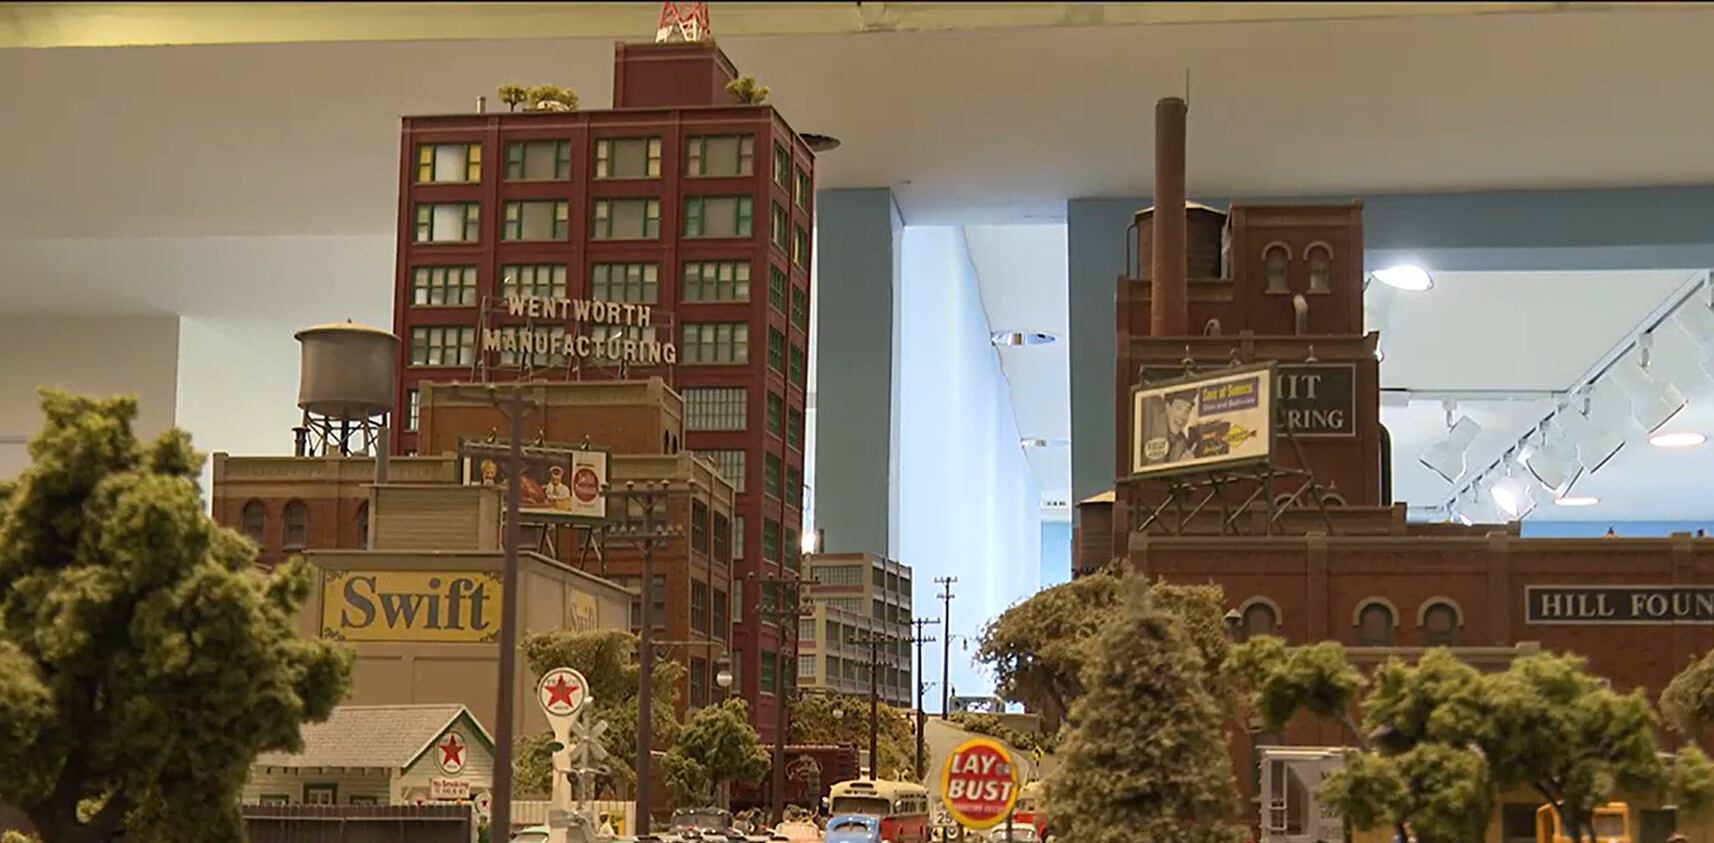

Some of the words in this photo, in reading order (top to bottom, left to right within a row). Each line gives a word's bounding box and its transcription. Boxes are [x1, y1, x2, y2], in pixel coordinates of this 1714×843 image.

[508, 295, 651, 327] WENTWORTH
[482, 328, 677, 364] MANUFACTURING
[341, 576, 490, 630] Swift
[1541, 594, 1615, 617] HILL
[951, 753, 997, 775] LAY
[948, 779, 1013, 801] BUST
